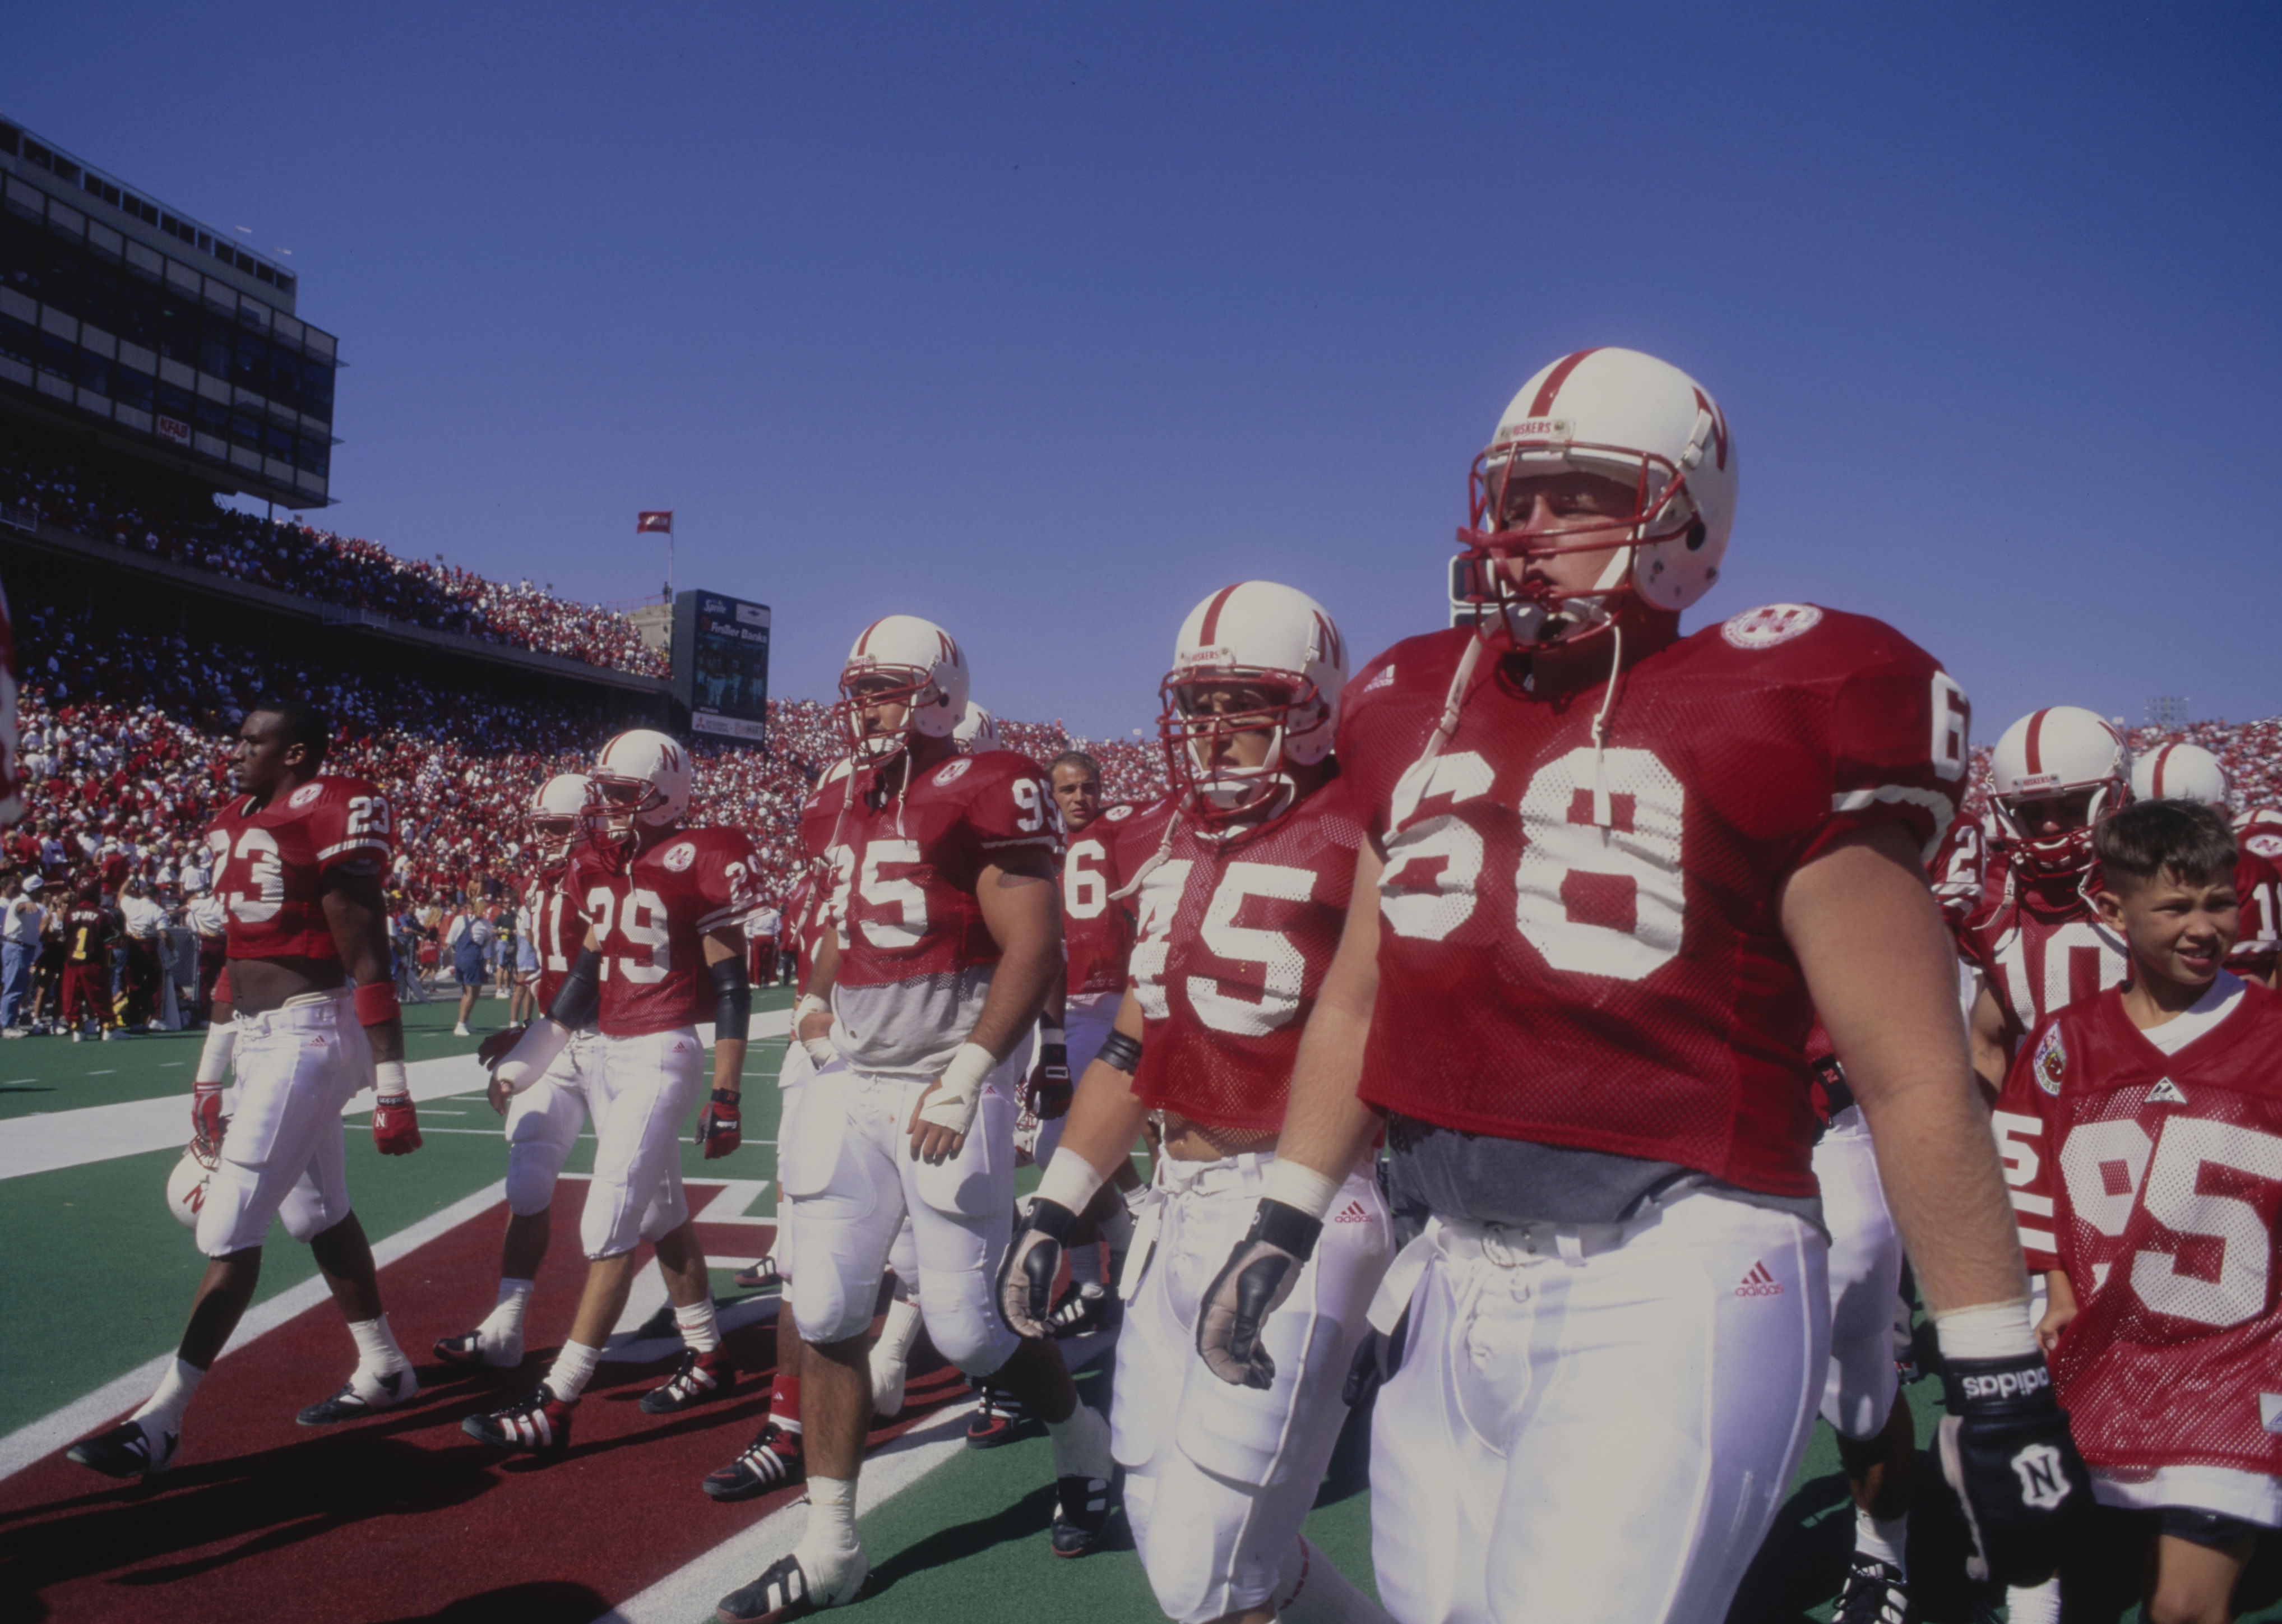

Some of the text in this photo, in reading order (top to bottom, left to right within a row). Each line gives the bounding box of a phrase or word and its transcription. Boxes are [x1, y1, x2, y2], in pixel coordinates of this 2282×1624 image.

[160, 417, 188, 438] KFAB
[703, 599, 728, 614] Sprite
[741, 628, 767, 644] Banks
[936, 630, 959, 668] N
[1312, 609, 1340, 670] N
[977, 711, 993, 739] N
[1931, 670, 1971, 782] 6
[659, 743, 679, 773] N
[346, 796, 390, 835] 23
[1064, 839, 1107, 919] 6
[1377, 746, 1686, 982] 68
[72, 927, 88, 960] 1
[586, 886, 671, 984] 29
[1128, 858, 1317, 1037] 45
[1993, 921, 2128, 1031] 10
[376, 1113, 386, 1127] N
[1334, 1214, 1373, 1223] adidas
[2059, 1114, 2282, 1327] 95
[1734, 1282, 1784, 1297] adidas
[1962, 1366, 2050, 1400] adidas
[2019, 1452, 2059, 1499] N
